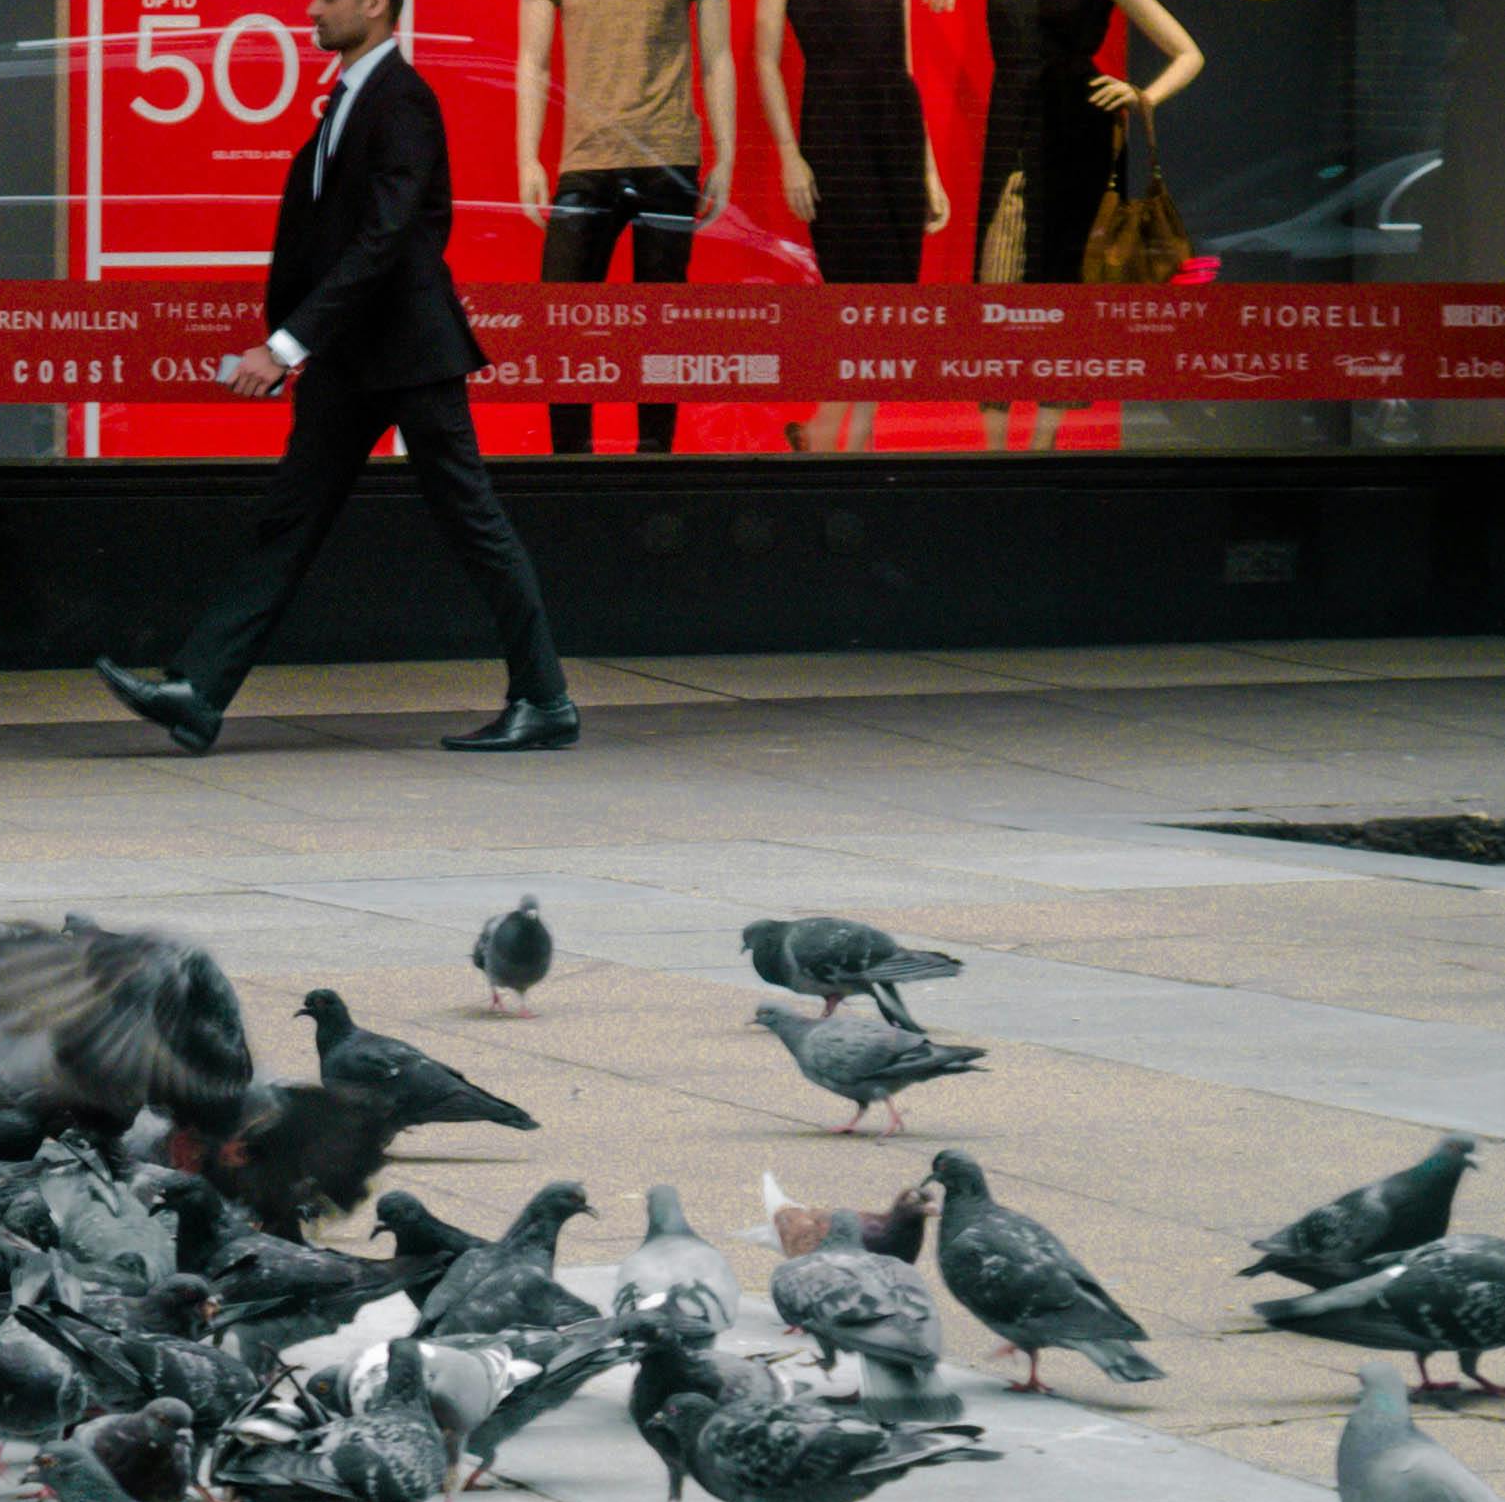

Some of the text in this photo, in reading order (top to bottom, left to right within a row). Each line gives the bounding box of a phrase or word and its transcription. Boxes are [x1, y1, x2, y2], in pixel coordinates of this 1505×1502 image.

[151, 302, 265, 319] THERAPY
[547, 304, 648, 326] HOBBS
[840, 306, 947, 325] OFFICE
[982, 303, 1065, 323] Dune
[1095, 301, 1209, 318] THERAPY
[1240, 305, 1401, 327] FIORELLI
[50, 310, 139, 330] MILLEN
[13, 355, 124, 384] coast
[557, 356, 621, 384] lab
[839, 359, 918, 380] DKNY
[940, 359, 1147, 378] KURT GEIGER
[1175, 353, 1311, 371] FANTASIE
